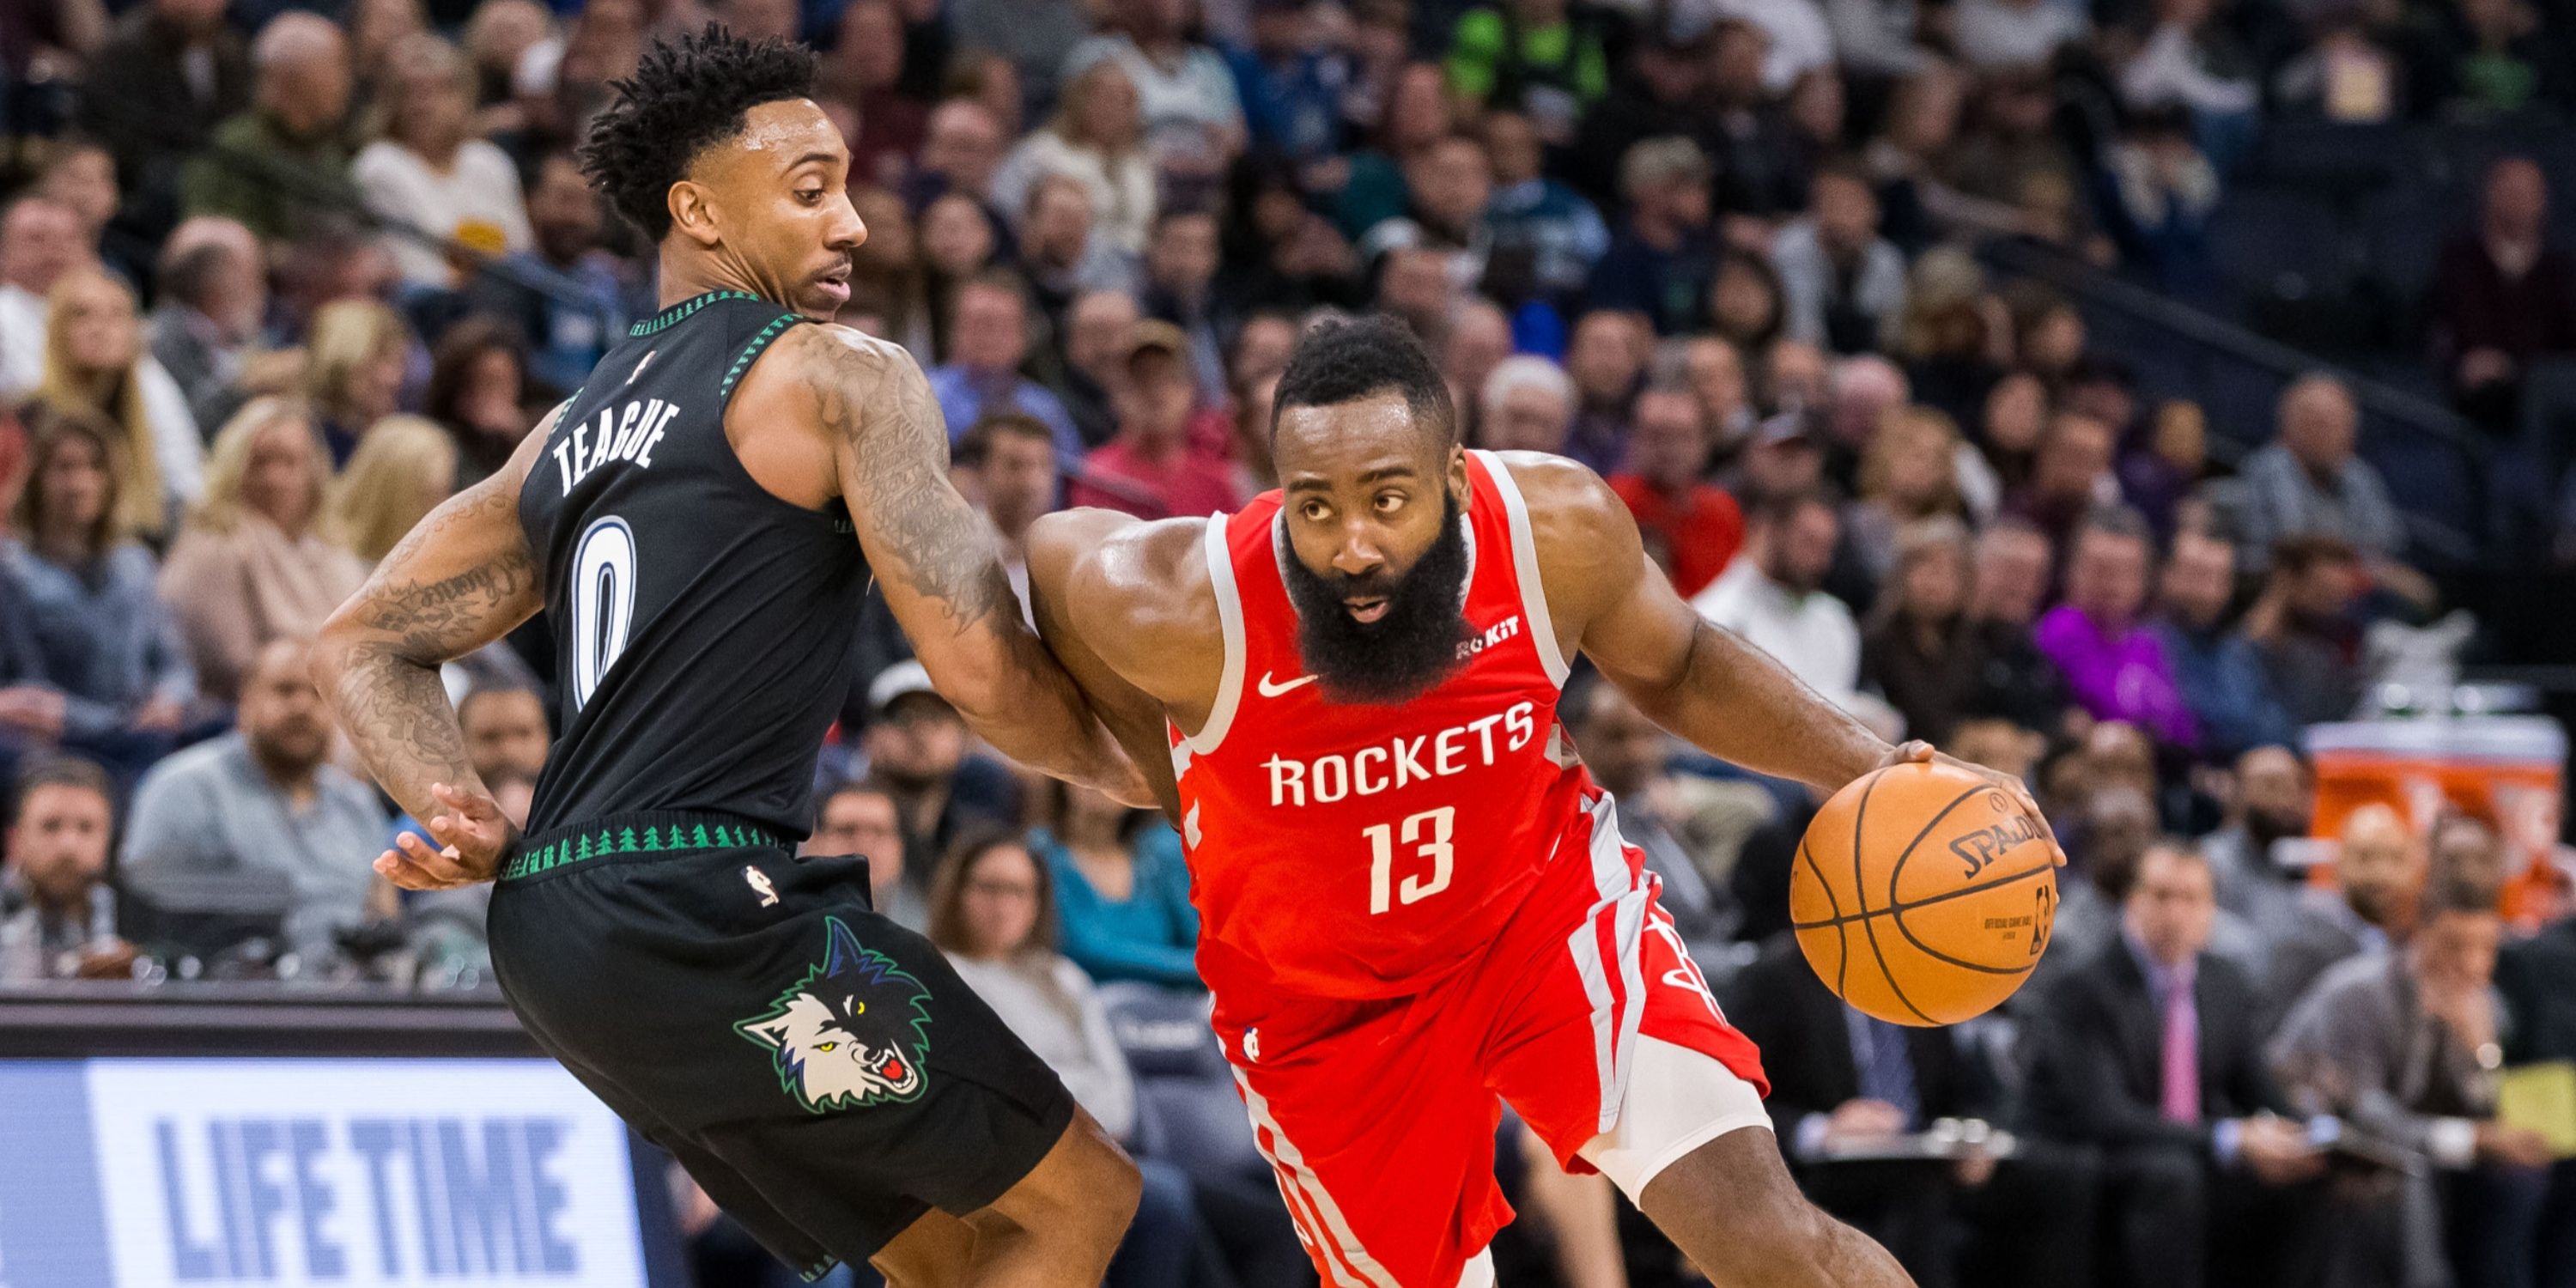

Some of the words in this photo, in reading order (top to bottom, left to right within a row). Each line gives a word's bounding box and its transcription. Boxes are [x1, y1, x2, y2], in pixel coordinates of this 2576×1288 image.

[552, 398, 680, 498] TEAGUE
[572, 514, 637, 714] 0
[1259, 701, 1534, 807] ROCKETS
[1362, 805, 1455, 915] 13
